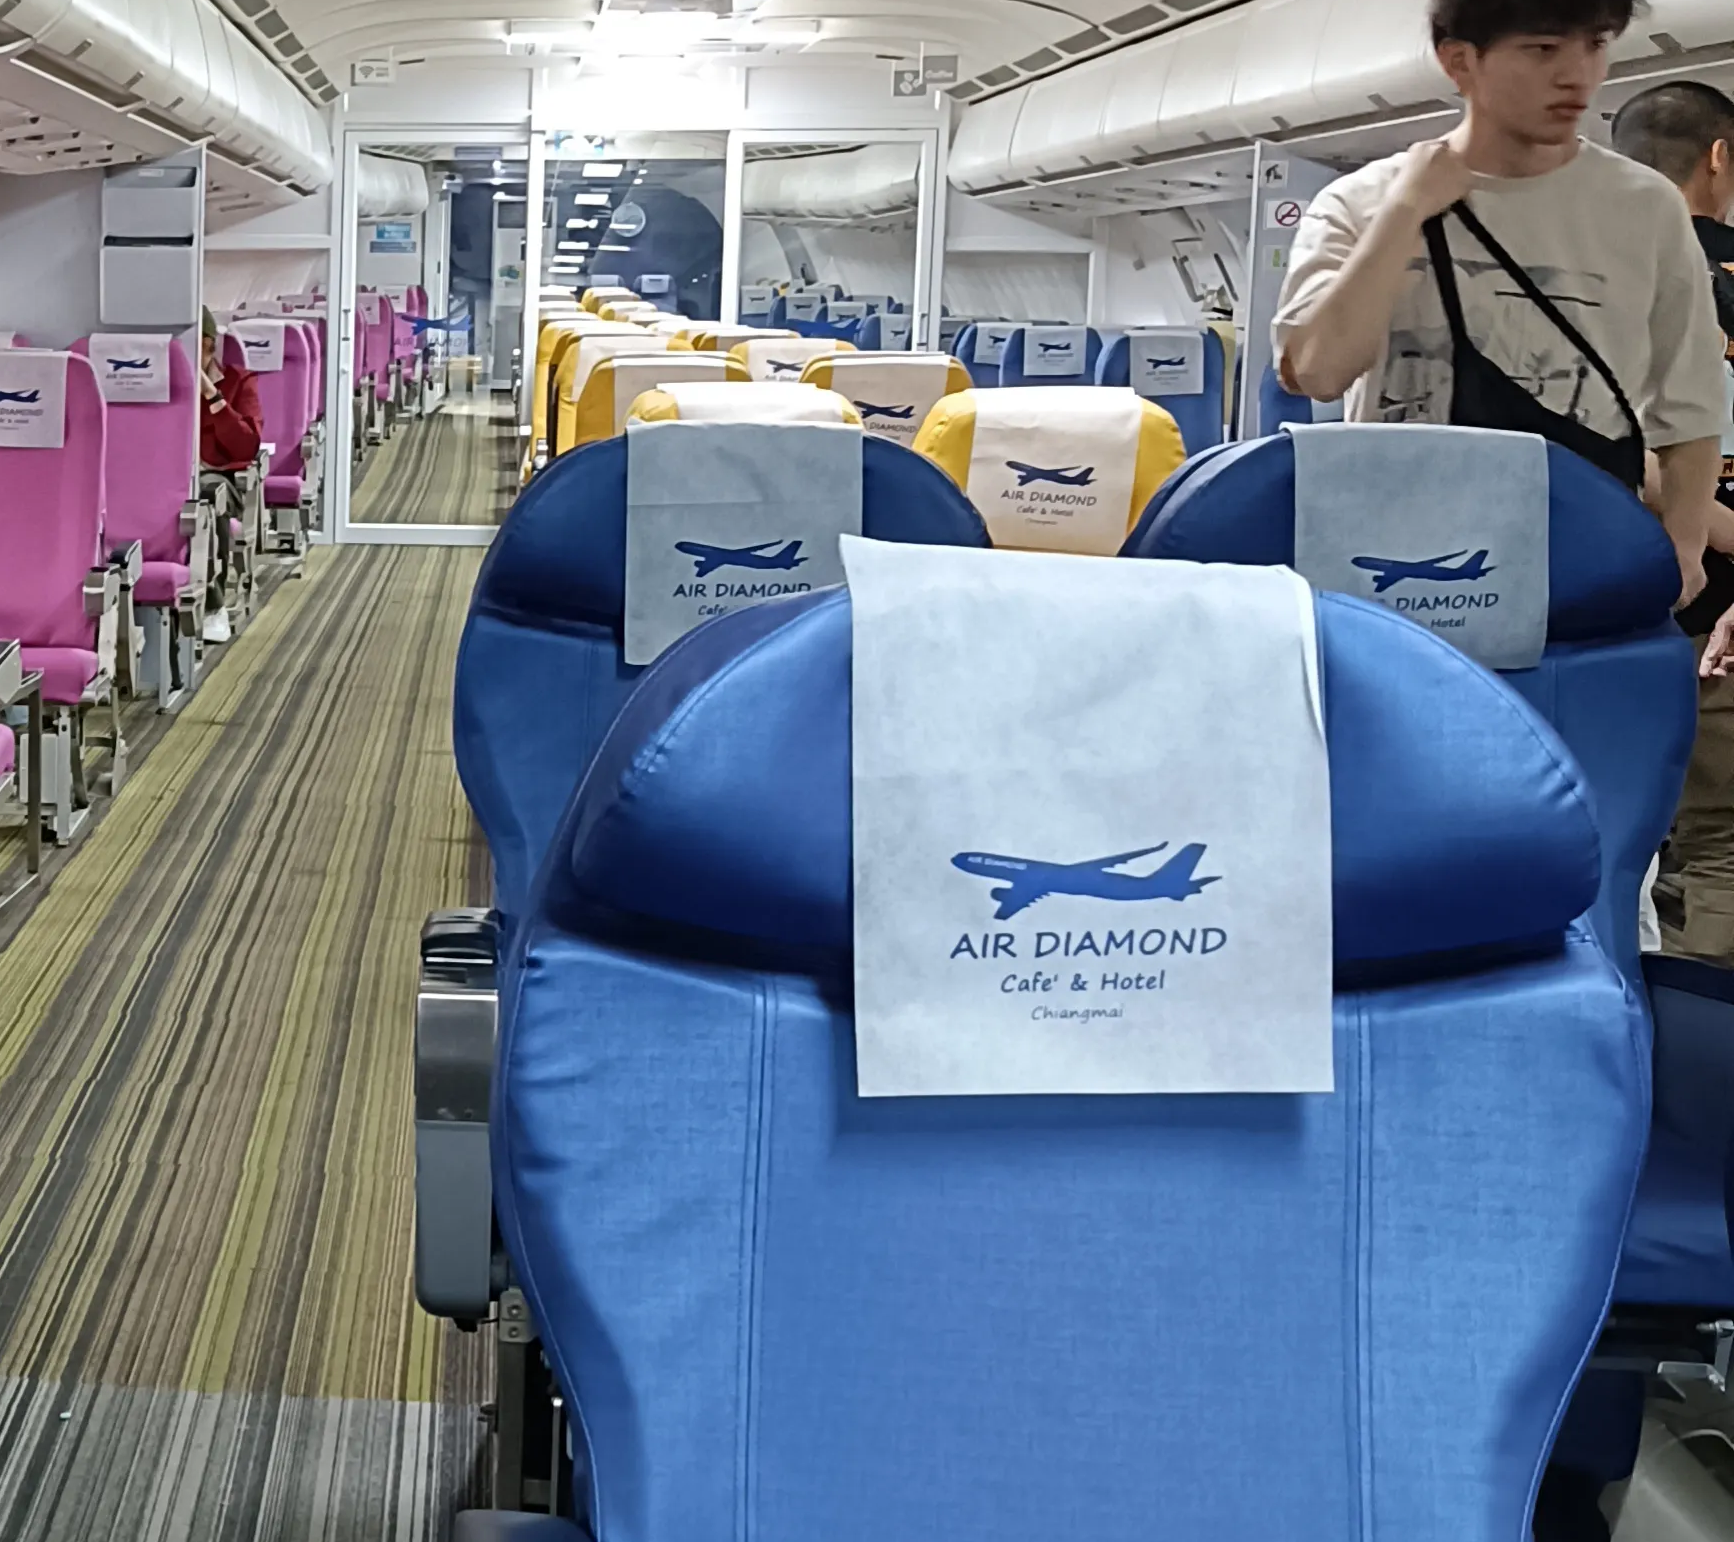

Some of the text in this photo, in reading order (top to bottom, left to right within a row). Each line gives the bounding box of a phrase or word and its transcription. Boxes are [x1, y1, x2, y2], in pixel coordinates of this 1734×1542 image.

[1001, 490, 1097, 506] AIR DIAMOND
[673, 583, 707, 598] AIR
[1396, 593, 1499, 612] DIAMOND
[1431, 616, 1466, 628] Hotel
[949, 927, 1227, 959] AIR DIAMOND
[1070, 973, 1089, 991] &
[1100, 969, 1166, 991] Hotel
[1030, 1004, 1124, 1024] Chiangmai
